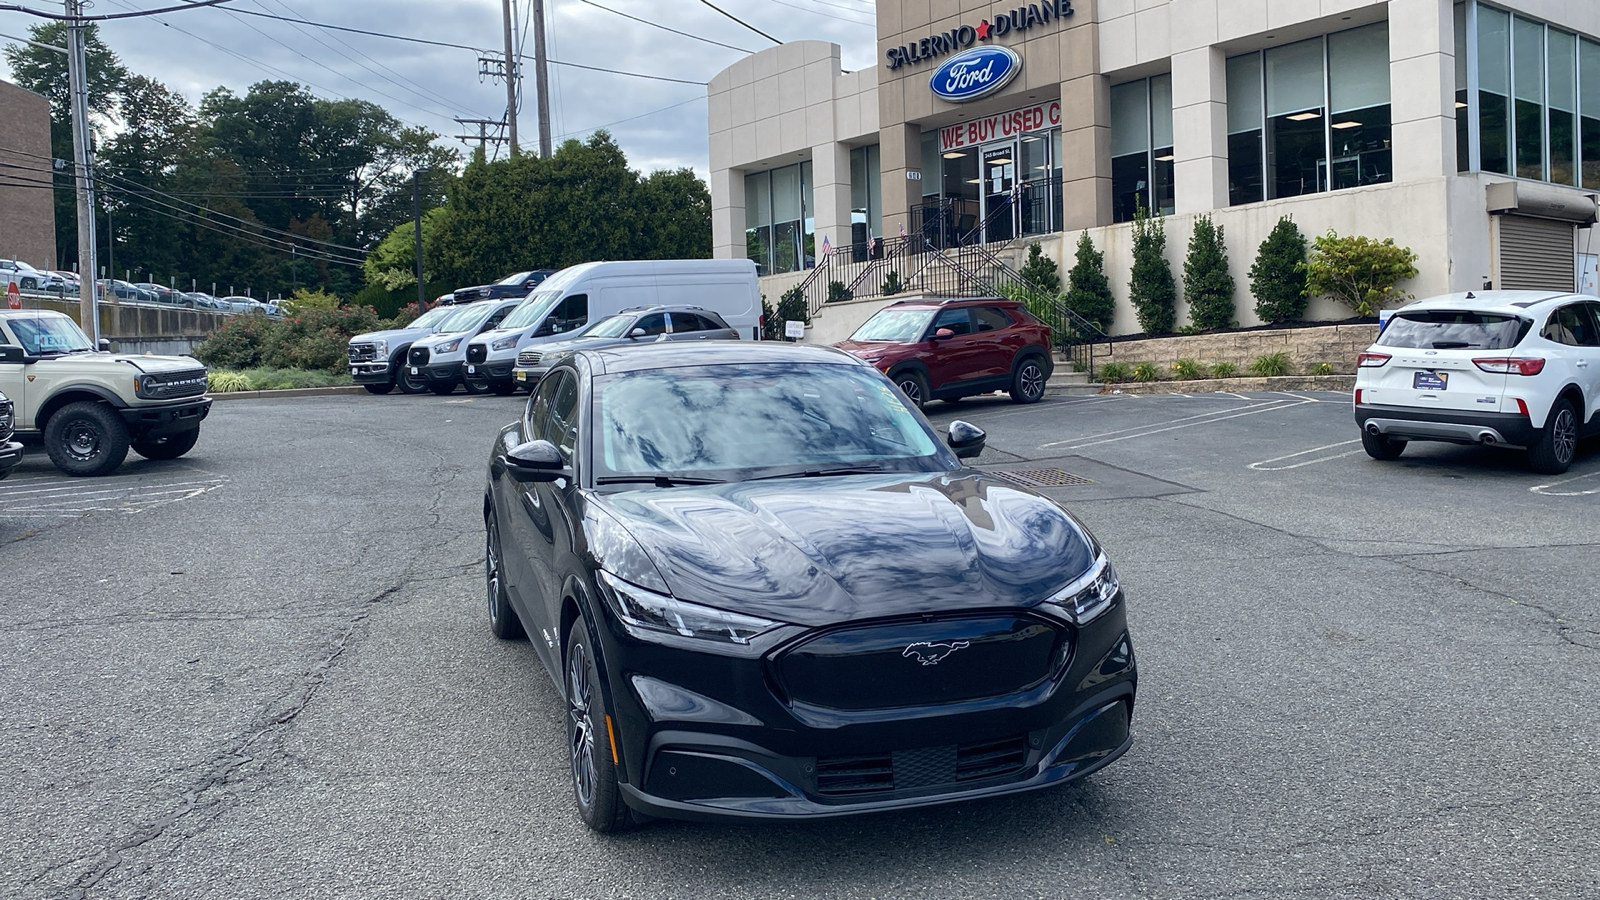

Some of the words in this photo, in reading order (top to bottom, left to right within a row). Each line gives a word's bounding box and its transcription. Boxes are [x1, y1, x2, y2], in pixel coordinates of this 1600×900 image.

[886, 25, 975, 70] SALERNO
[994, 0, 1074, 36] DUANE
[946, 58, 993, 92] Ford
[941, 125, 964, 149] WE
[968, 117, 998, 143] BUY
[1002, 107, 1044, 136] USED
[1048, 102, 1061, 124] C
[8, 292, 20, 306] STOP
